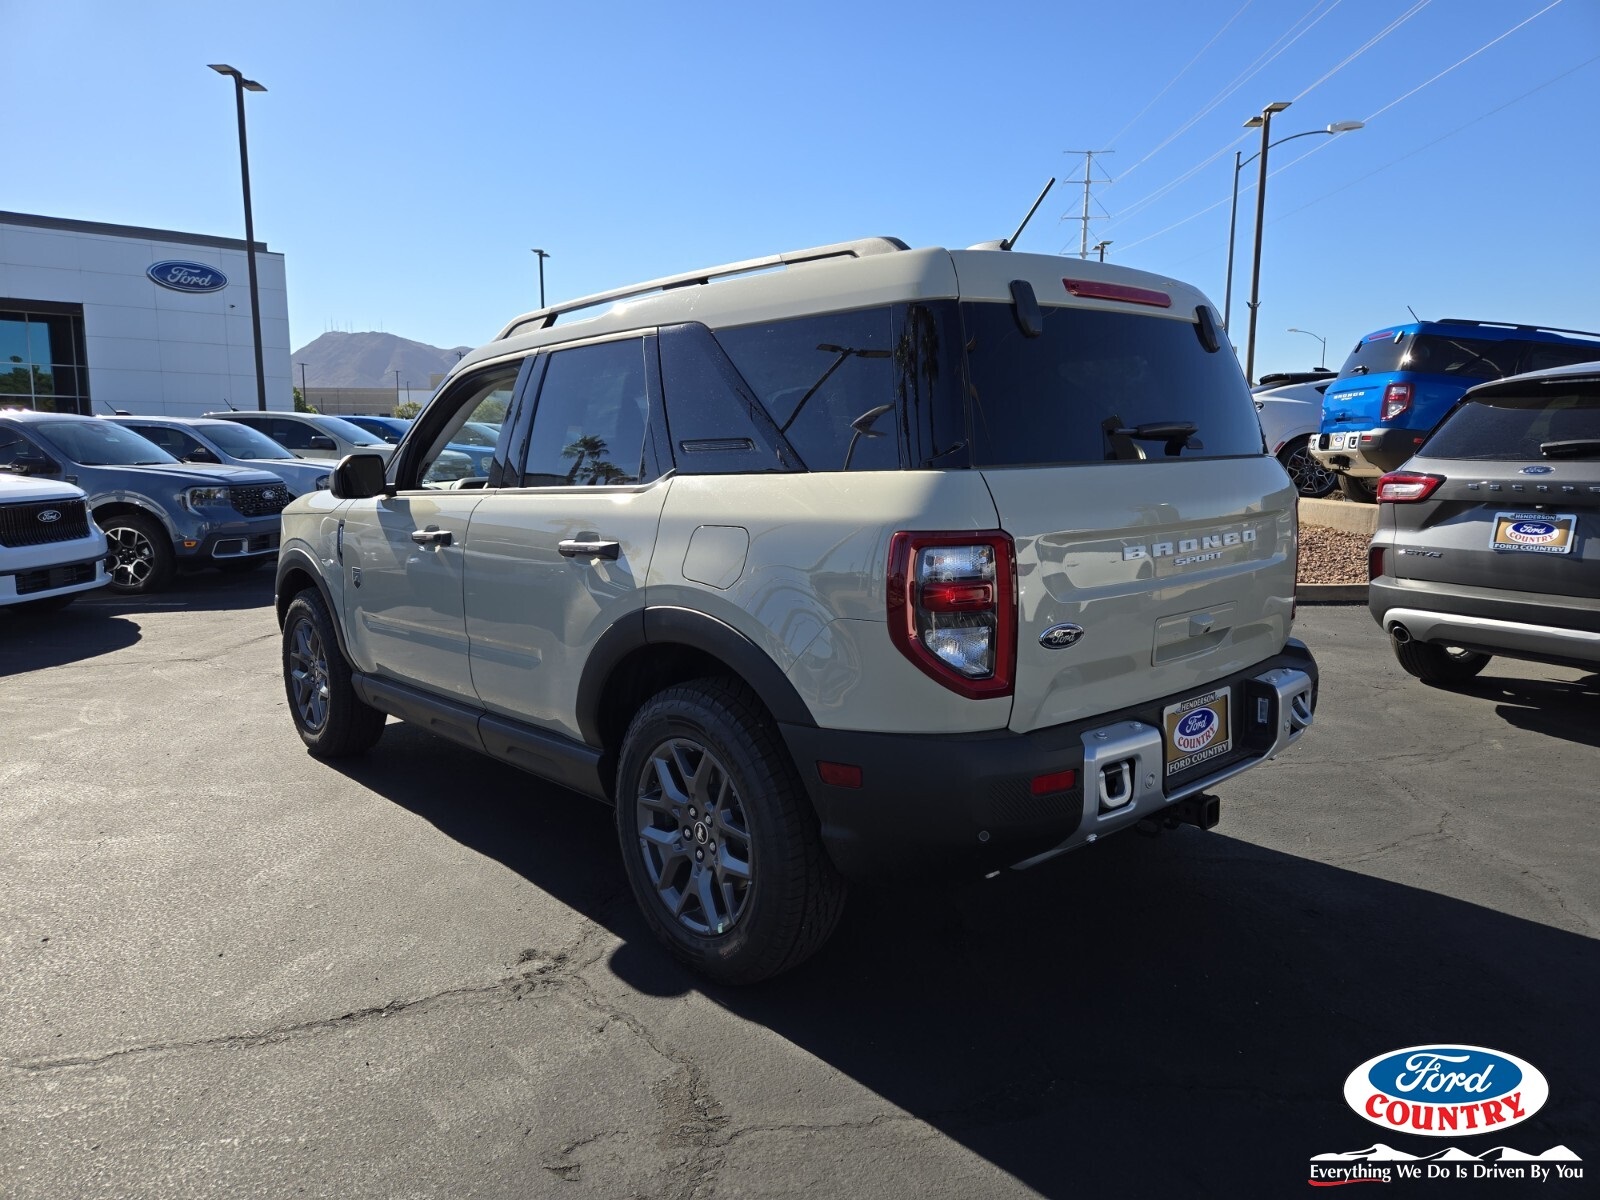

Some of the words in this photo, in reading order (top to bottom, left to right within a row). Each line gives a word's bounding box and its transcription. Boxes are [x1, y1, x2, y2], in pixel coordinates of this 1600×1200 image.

[167, 266, 212, 287] Ford
[1509, 531, 1554, 542] COUNTRY
[1519, 523, 1547, 534] Ford
[1123, 529, 1257, 561] BRONCO
[1520, 544, 1565, 552] COUNTRY
[1174, 551, 1223, 566] SPORT
[1181, 694, 1215, 711] HENDERSON
[1185, 713, 1208, 733] Ford
[1178, 723, 1215, 749] COUNTRY
[1169, 758, 1191, 773] FORD
[1192, 742, 1228, 762] COUNTRY
